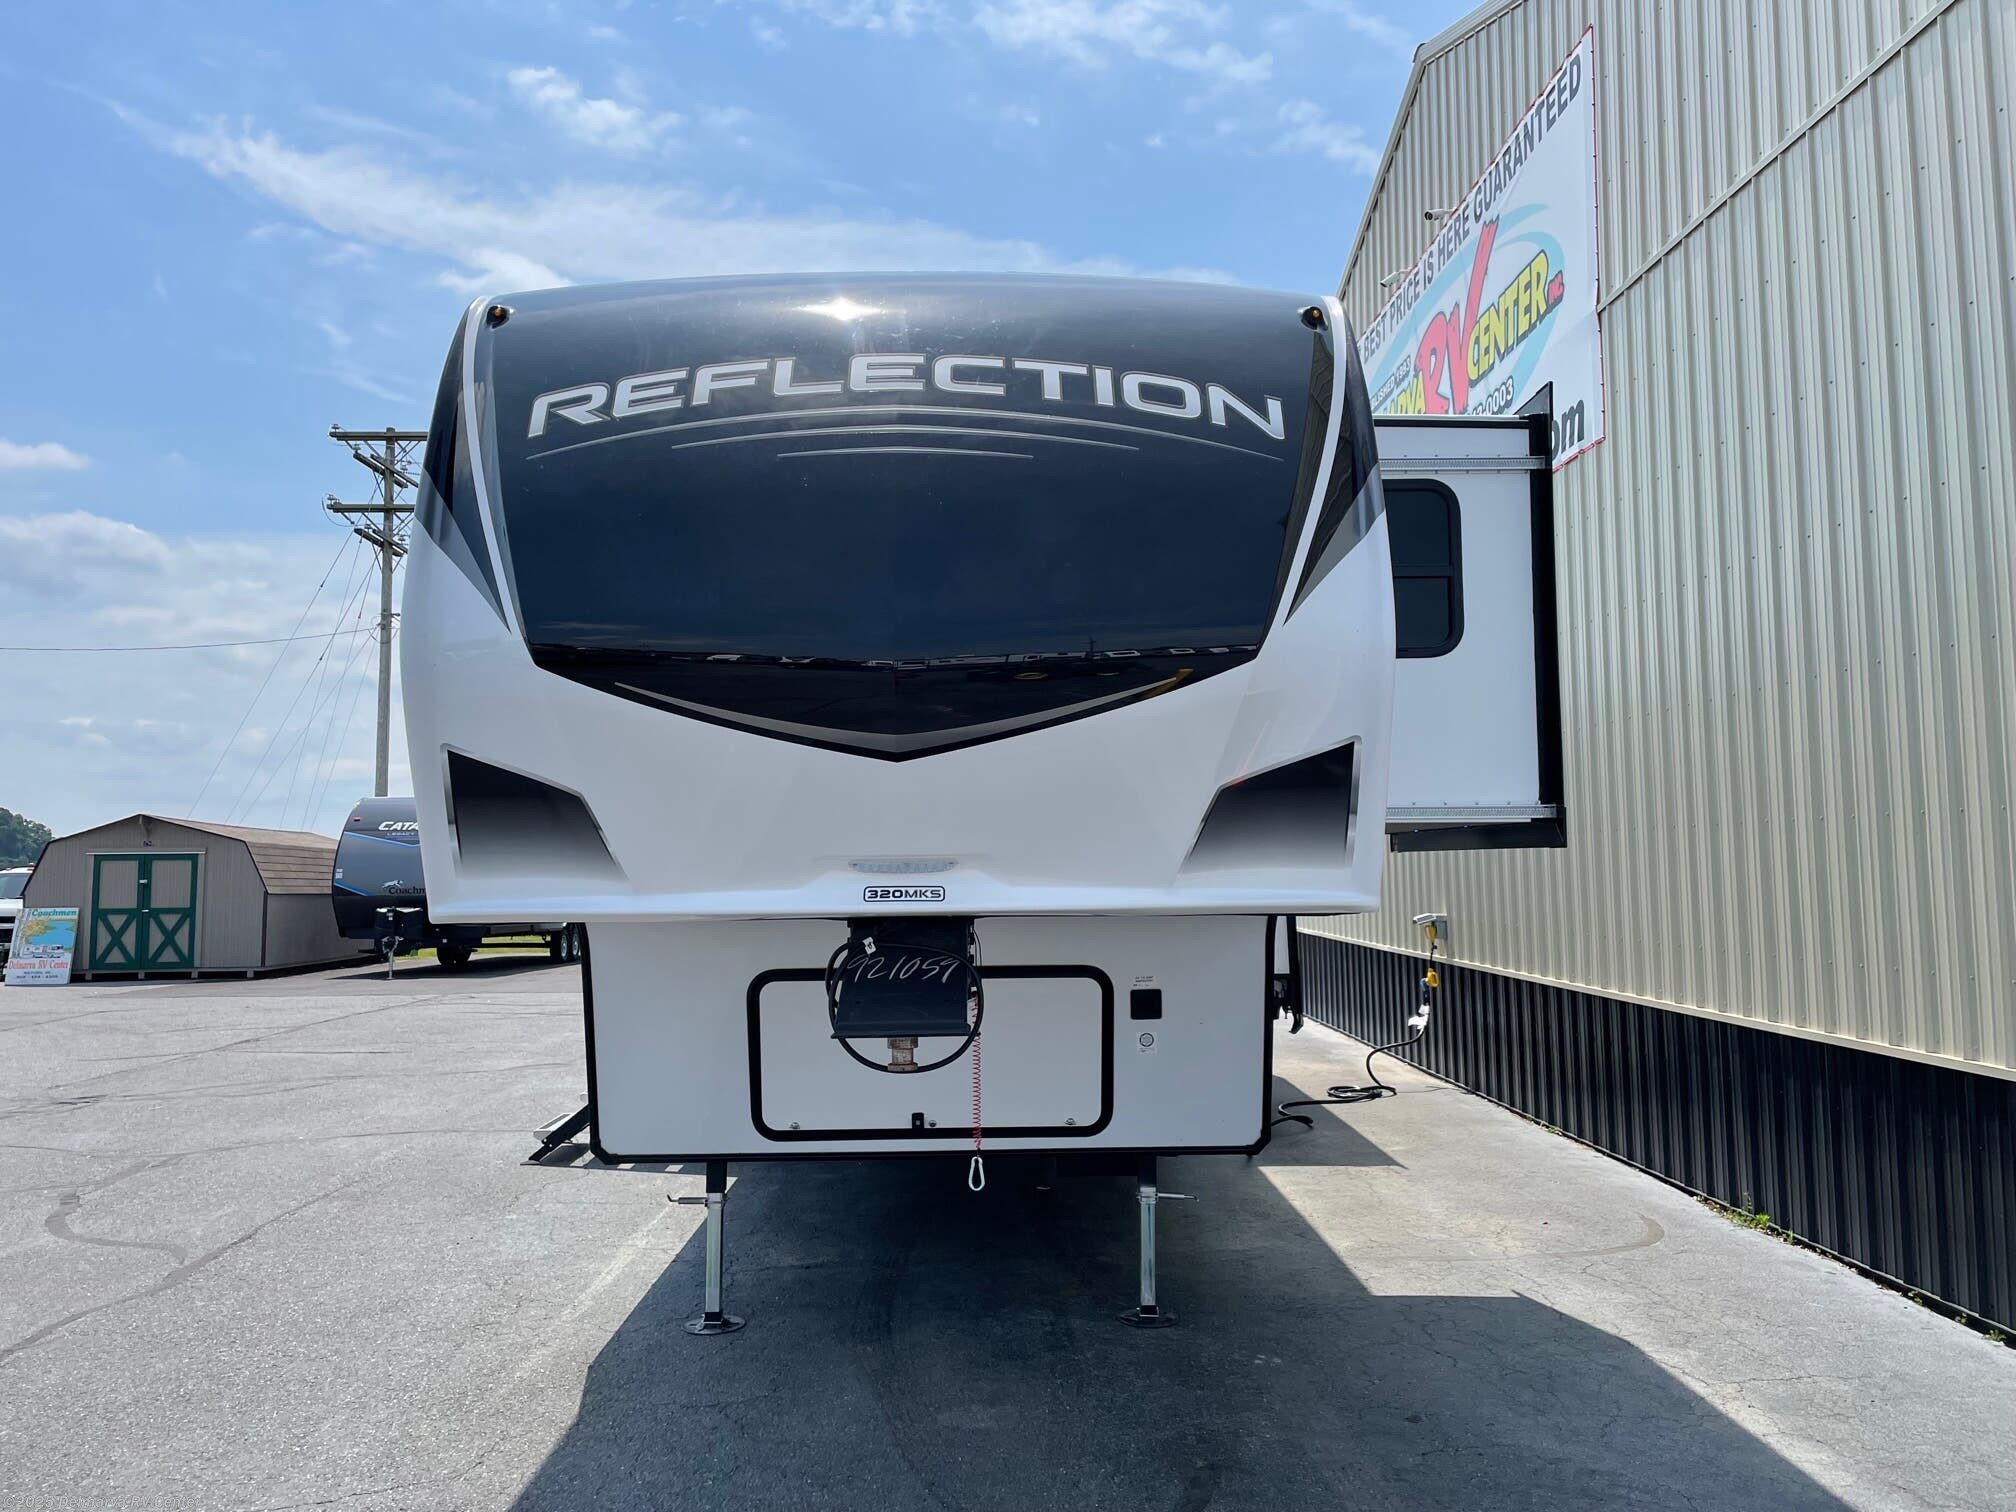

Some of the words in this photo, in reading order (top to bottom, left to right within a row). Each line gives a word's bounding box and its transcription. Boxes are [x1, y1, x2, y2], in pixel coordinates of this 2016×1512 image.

[1364, 311, 1387, 365] BEST
[1389, 271, 1420, 333] PRICE
[1423, 250, 1434, 291] IS
[1438, 200, 1470, 273] HERE
[1473, 54, 1581, 225] GUARANTEED
[1414, 215, 1500, 414] RV
[1466, 249, 1550, 387] CENTER
[526, 352, 1286, 440] REFLECTION
[31, 908, 77, 917] Coachmen
[866, 888, 943, 900] 320MKS
[38, 959, 47, 969] RV
[50, 959, 69, 969] Center
